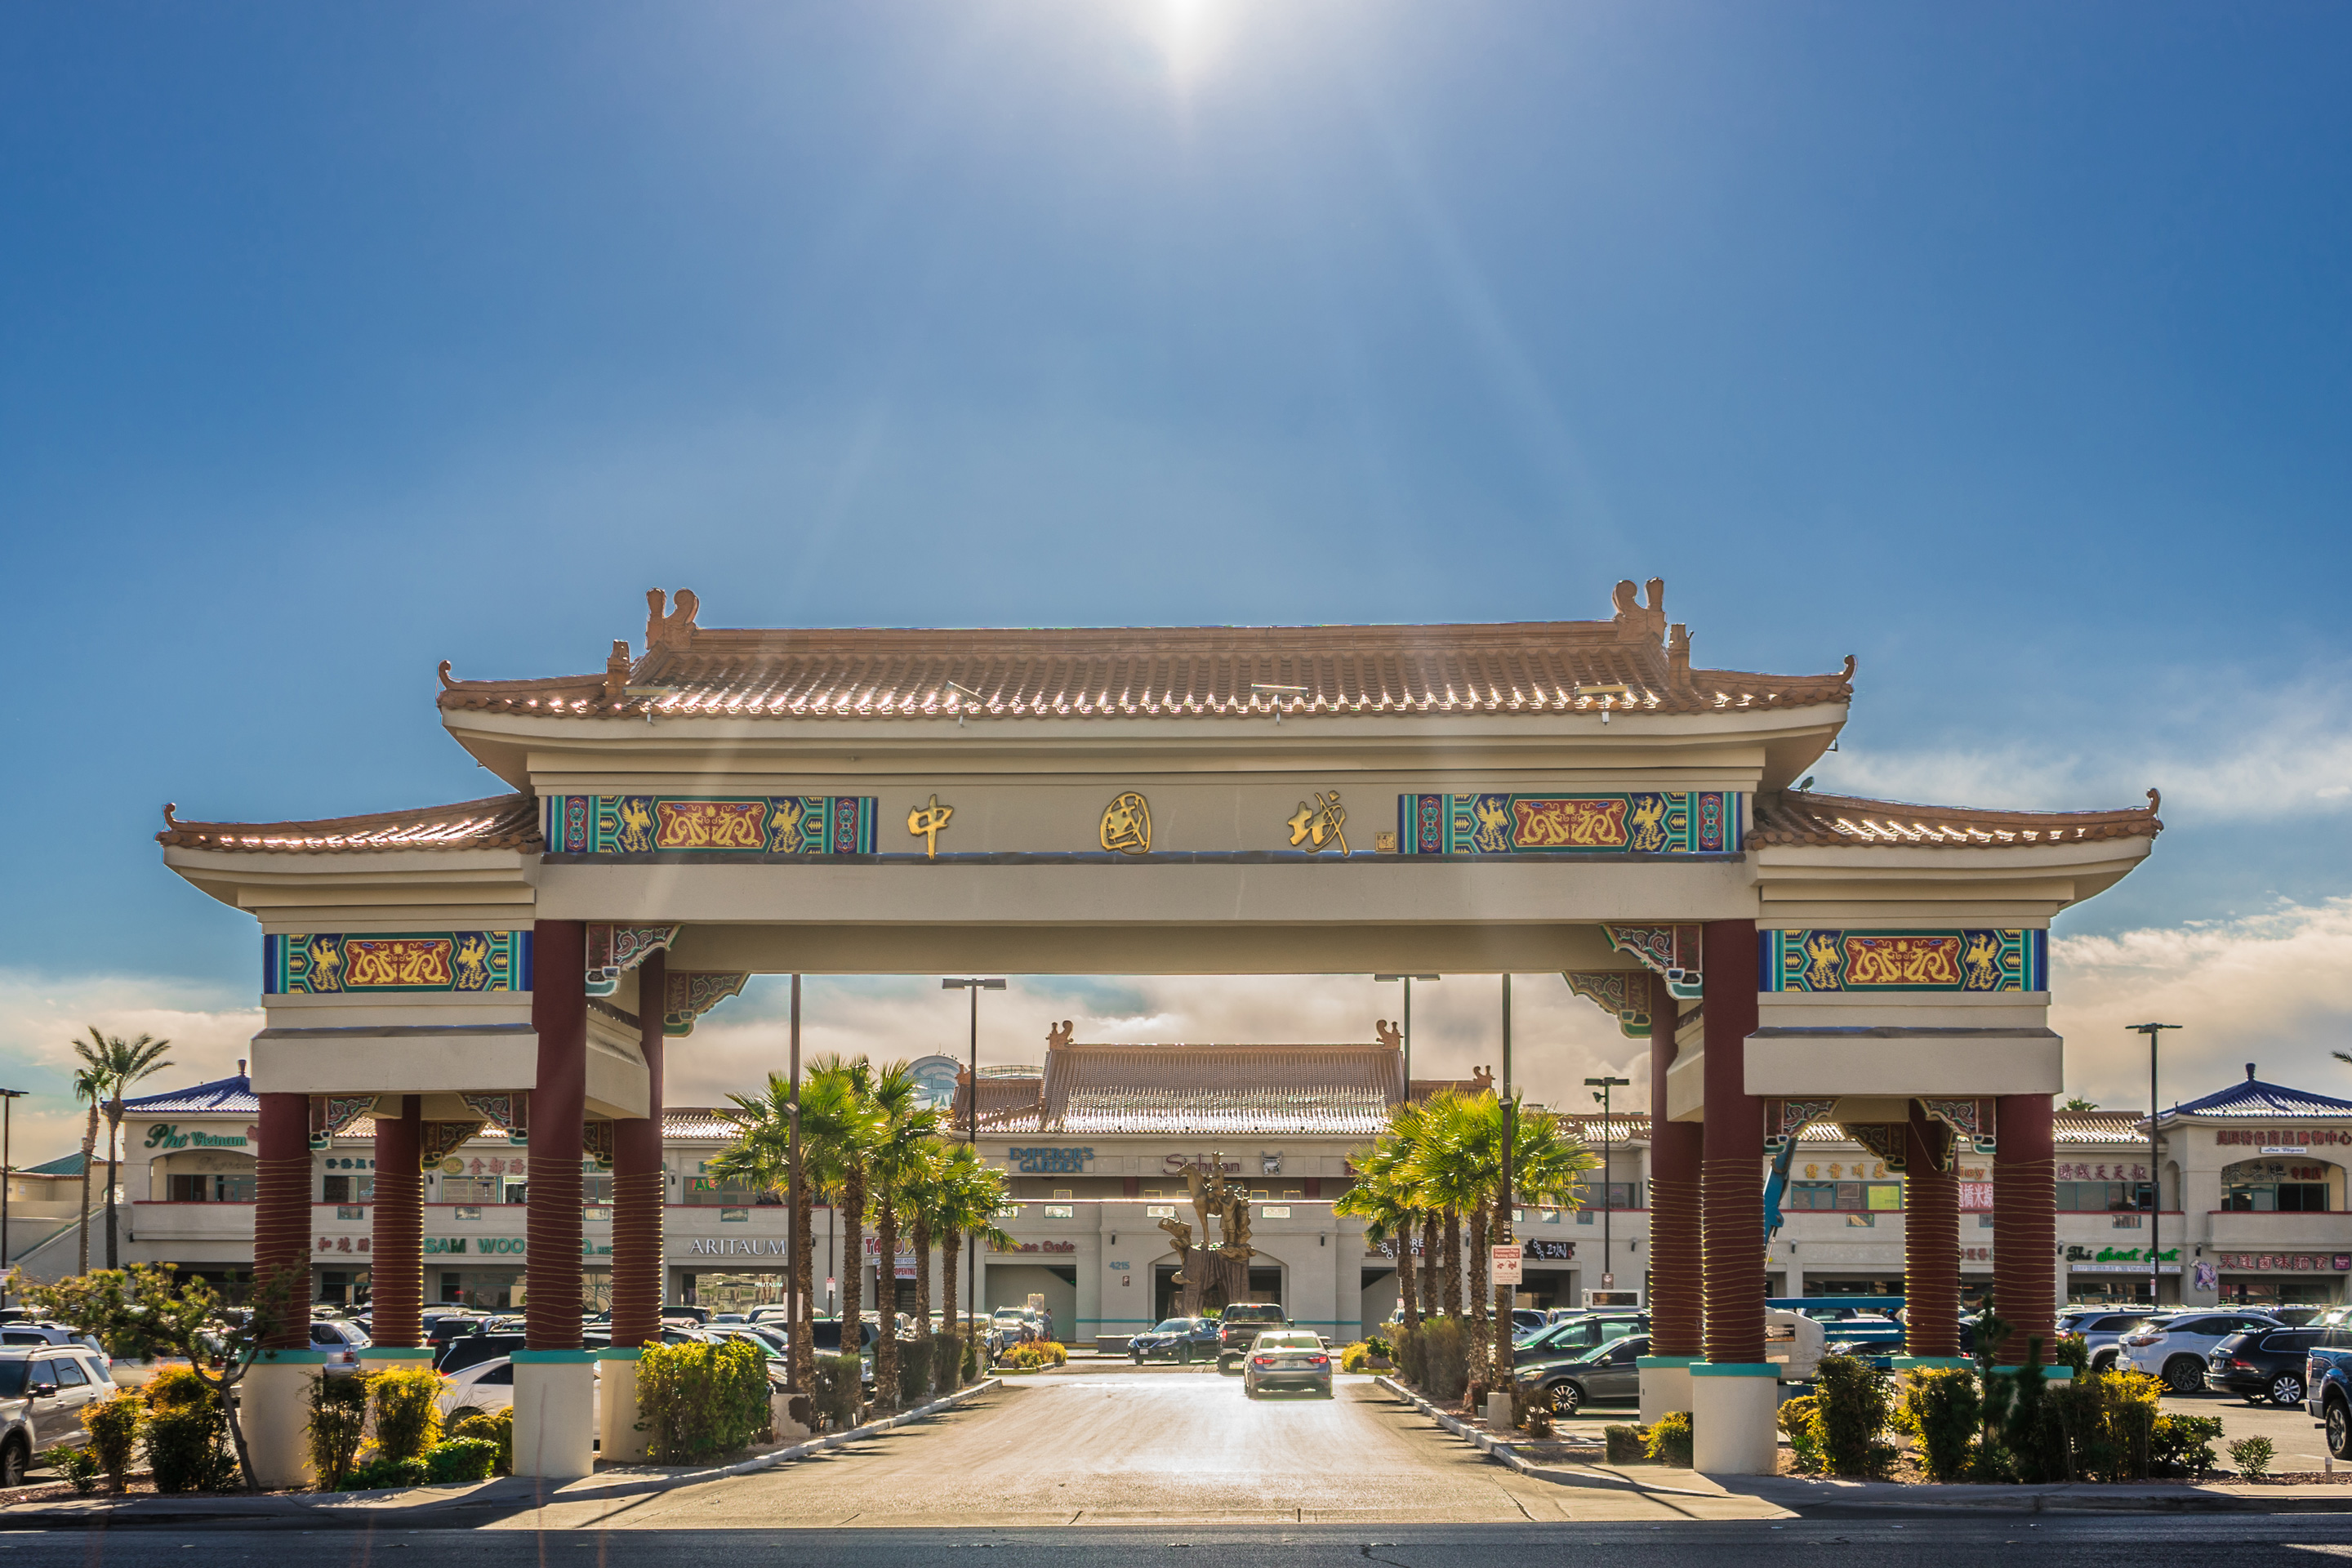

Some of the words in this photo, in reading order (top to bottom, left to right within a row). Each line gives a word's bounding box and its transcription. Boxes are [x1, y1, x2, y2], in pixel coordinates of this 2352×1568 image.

[907, 791, 1351, 860] 中國城
[190, 1131, 247, 1147] Vietnam
[1009, 1147, 1094, 1160] EMPEROR'S
[1019, 1160, 1084, 1173] GARDEN
[1162, 1153, 1240, 1175] Shan
[2221, 1164, 2287, 1183] 界名牌
[423, 1238, 466, 1254] SAM
[477, 1238, 524, 1254] WOO
[688, 1239, 786, 1255] ARITAUM
[2096, 1246, 2143, 1263] Sweet
[1109, 1261, 1130, 1271] 4215
